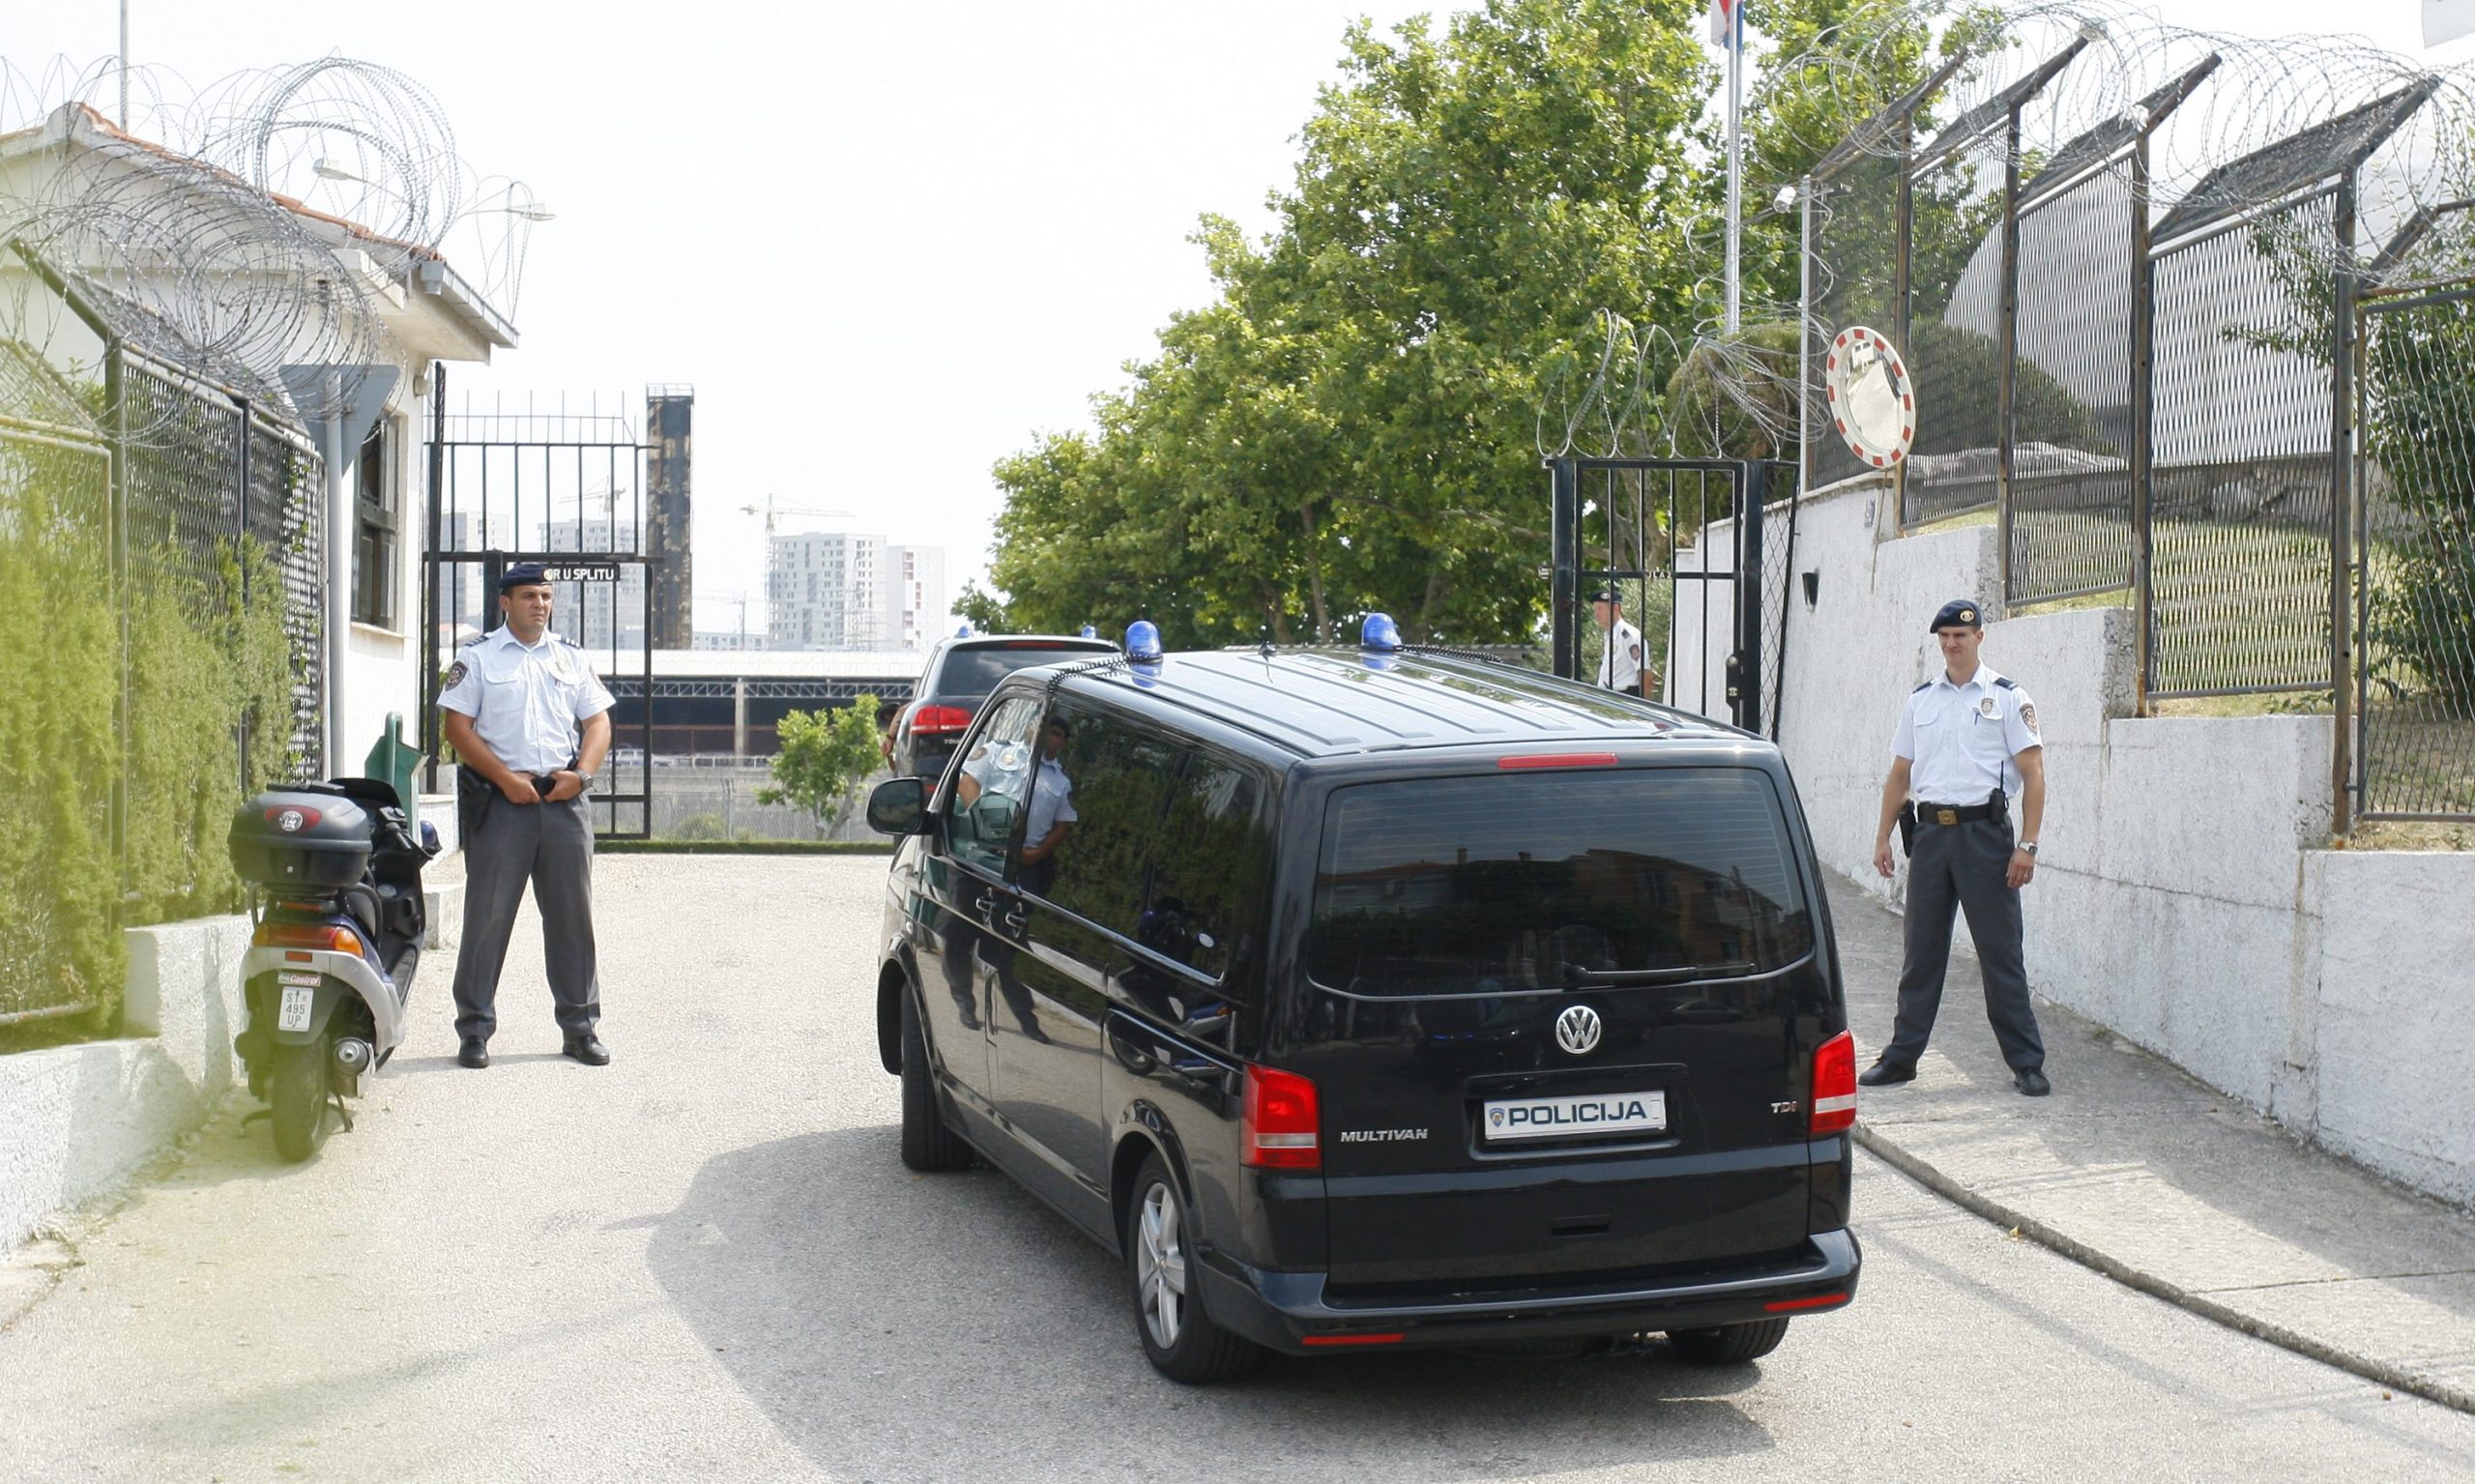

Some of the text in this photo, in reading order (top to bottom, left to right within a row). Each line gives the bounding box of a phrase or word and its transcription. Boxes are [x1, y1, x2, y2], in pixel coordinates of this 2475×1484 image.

[563, 567, 571, 580] U
[572, 567, 615, 581] SPLITU
[286, 1004, 306, 1014] 495
[287, 1015, 301, 1026] UP
[1508, 1100, 1646, 1126] POLICIJA
[1340, 1128, 1429, 1143] MULTIVAN
